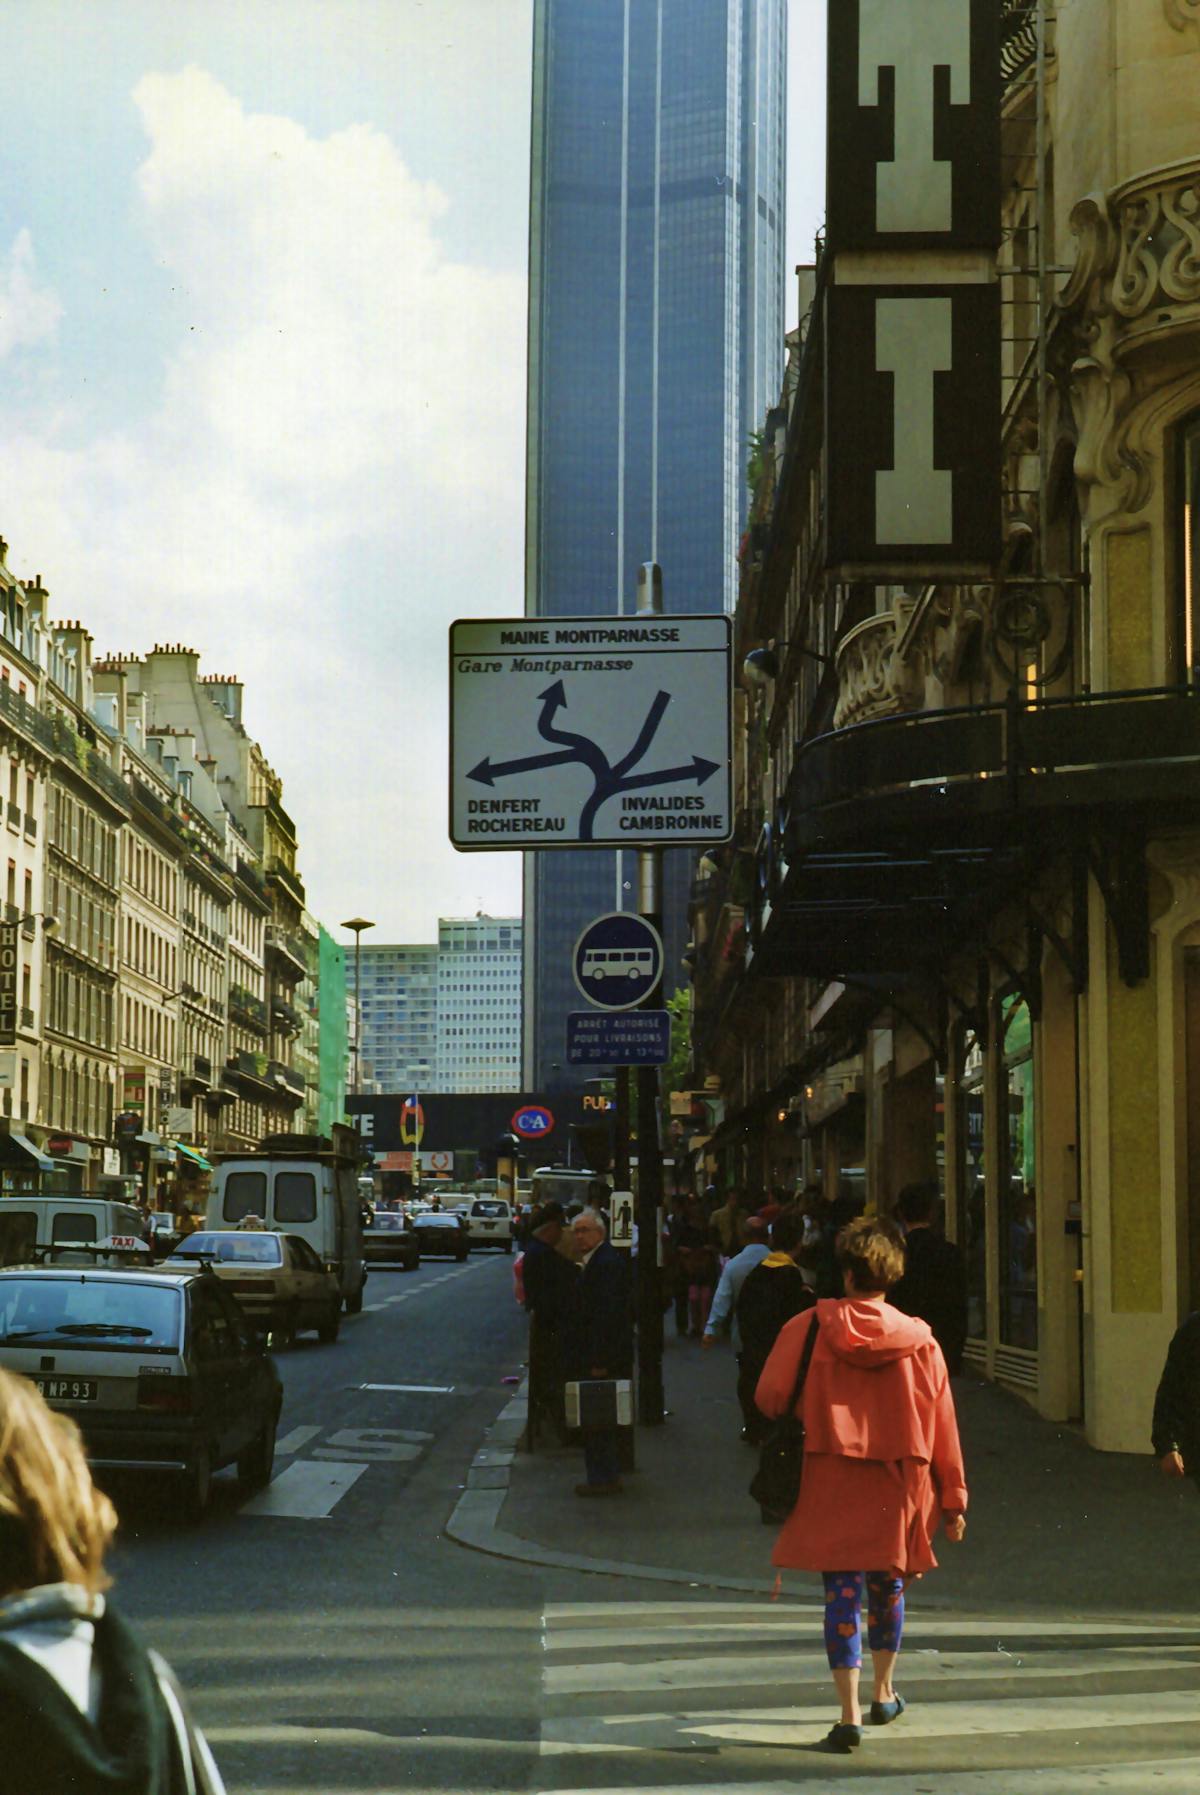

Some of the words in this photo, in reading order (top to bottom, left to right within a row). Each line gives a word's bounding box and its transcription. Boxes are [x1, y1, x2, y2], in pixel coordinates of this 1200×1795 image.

[500, 631, 549, 645] MAINE
[555, 628, 680, 644] MONTPARNASSE
[458, 659, 502, 673] Gare
[510, 658, 633, 675] Montparnasse
[468, 799, 540, 814] DENFERT
[622, 796, 705, 811] INVALIDES
[468, 818, 566, 833] ROCHEREAU
[619, 815, 723, 831] CAMBRONNE
[0, 927, 15, 1032] HOTEL
[605, 1033, 662, 1043] LIVRAISONS
[111, 1237, 135, 1247] TAXI
[72, 1382, 90, 1398] 93
